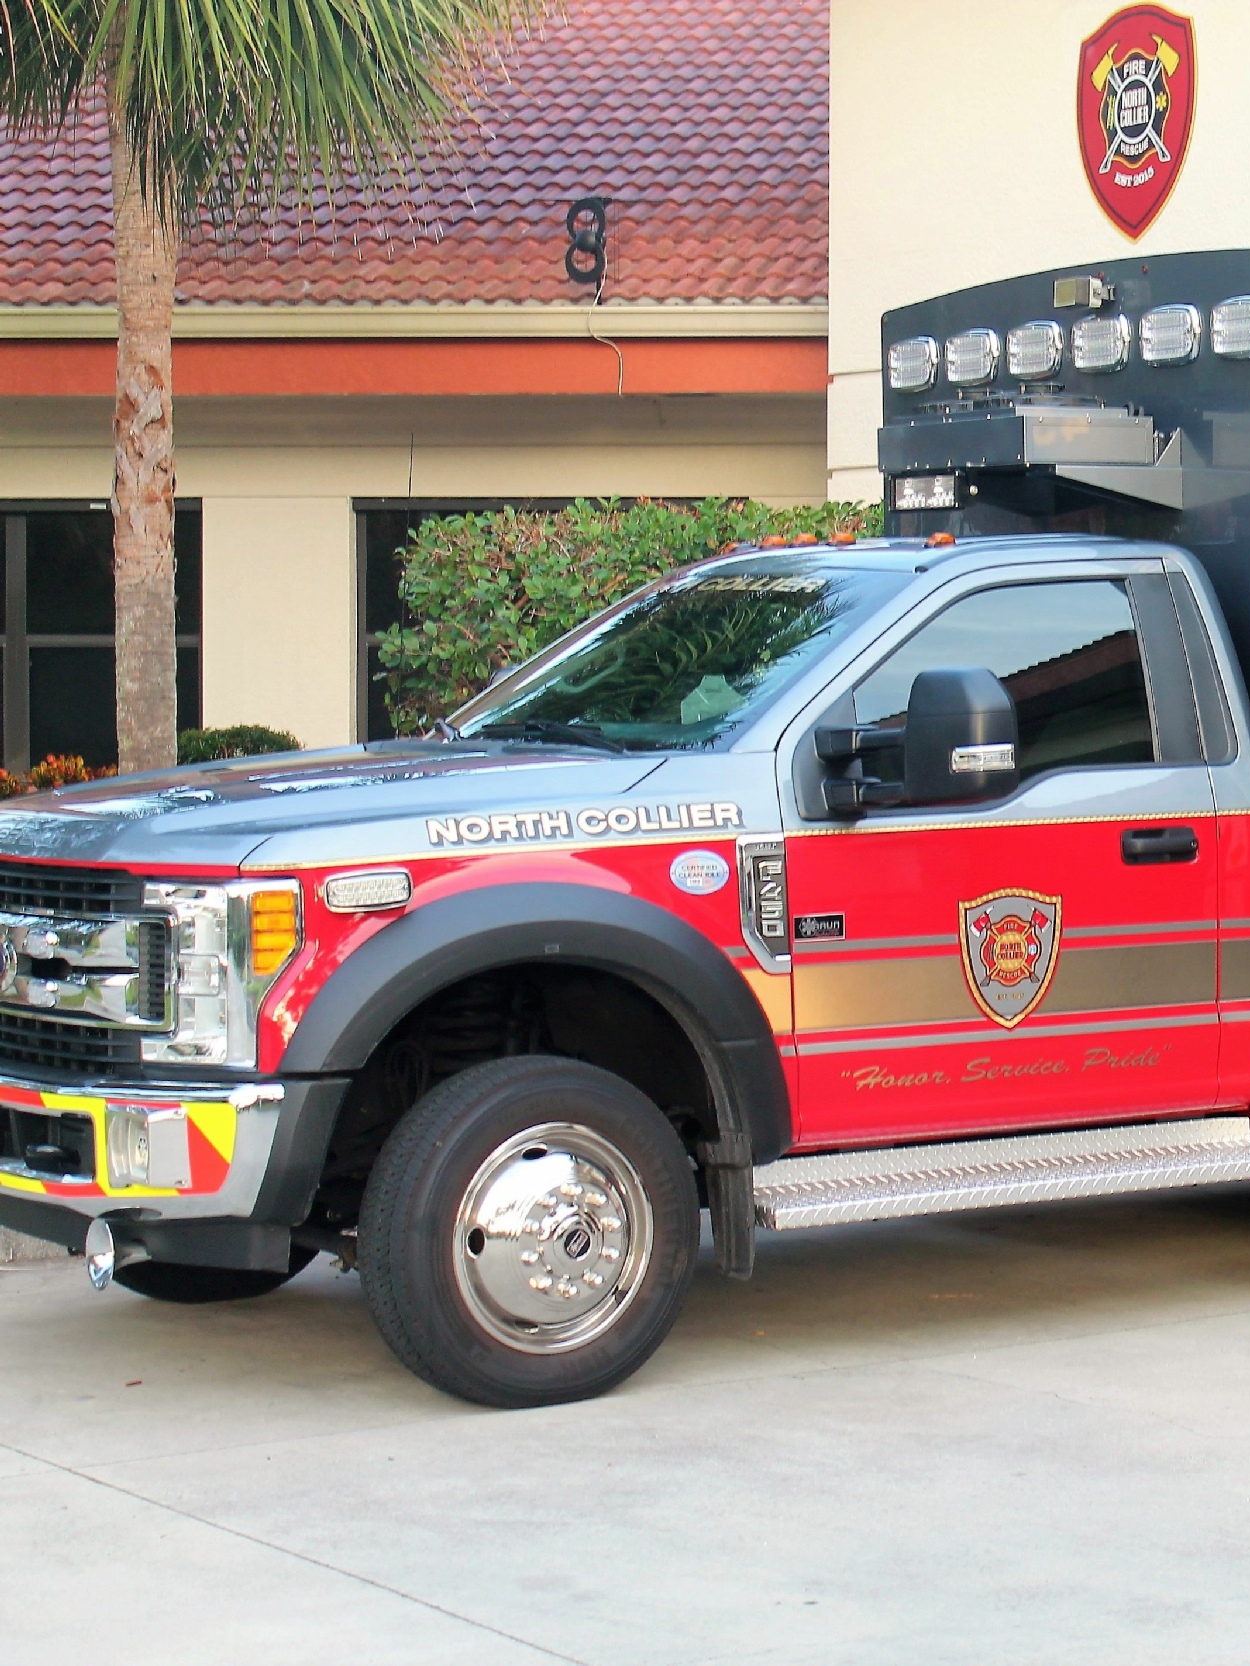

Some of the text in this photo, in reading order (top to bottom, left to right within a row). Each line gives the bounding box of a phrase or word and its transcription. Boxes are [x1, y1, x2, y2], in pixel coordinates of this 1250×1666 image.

[1123, 60, 1146, 78] FIRE
[1121, 86, 1147, 108] NORTH
[1120, 105, 1149, 128] COLLIER
[1120, 139, 1149, 156] RESCUE
[1114, 171, 1132, 187] EST
[565, 198, 606, 283] 8
[426, 801, 746, 847] NORTH COLLIER
